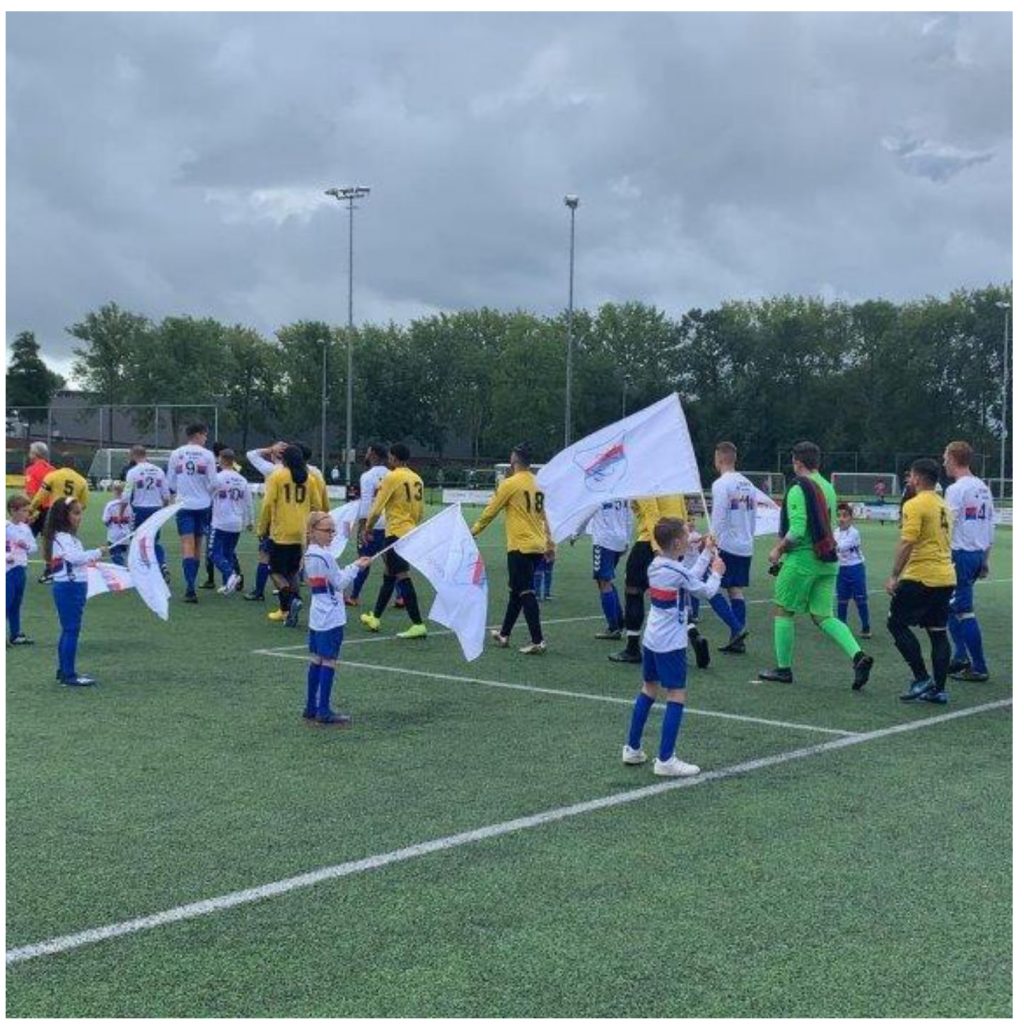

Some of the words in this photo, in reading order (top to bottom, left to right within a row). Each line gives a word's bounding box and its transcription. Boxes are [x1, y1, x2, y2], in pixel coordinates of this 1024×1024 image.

[185, 460, 195, 476] 9
[63, 479, 75, 496] 5
[403, 481, 423, 501] 13
[523, 490, 545, 513] 18
